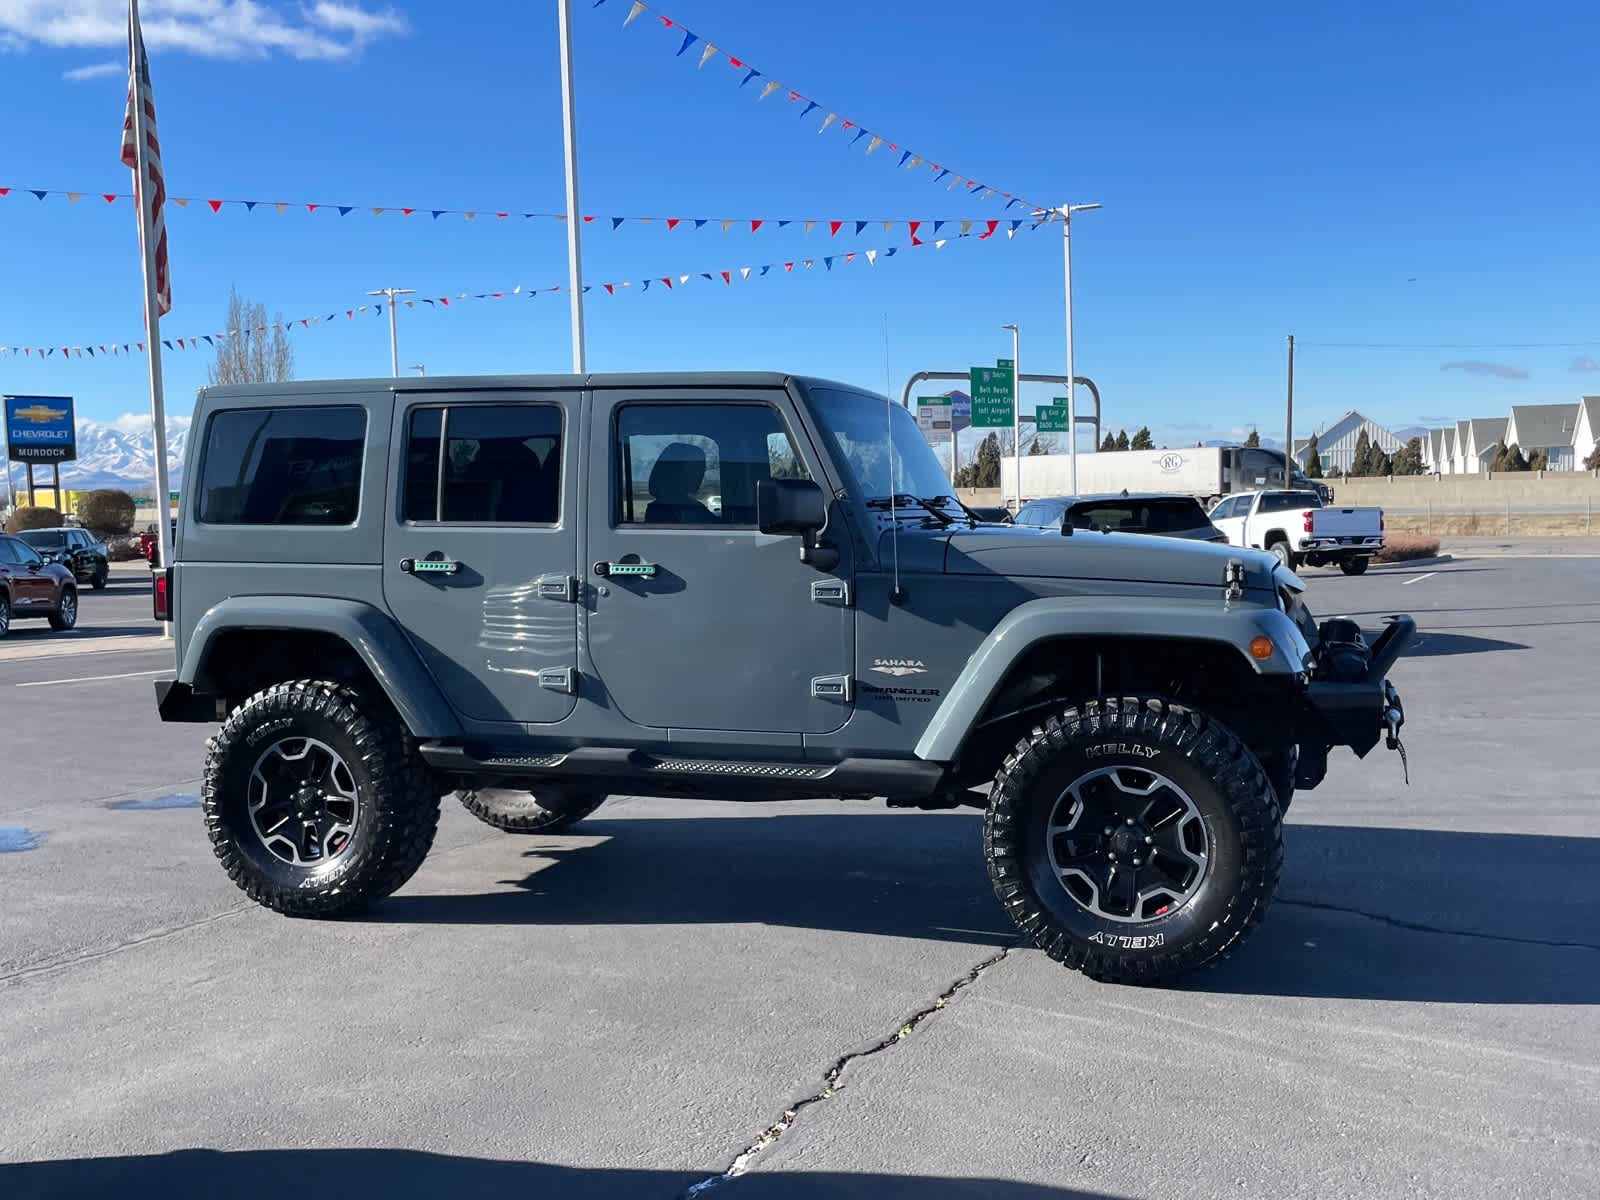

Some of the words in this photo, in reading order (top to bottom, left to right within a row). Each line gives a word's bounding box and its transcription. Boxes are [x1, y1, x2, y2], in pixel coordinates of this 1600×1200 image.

[12, 430, 69, 439] CHEVROLET
[18, 448, 65, 457] MURDOCK
[874, 658, 924, 667] SAHARA
[862, 686, 940, 696] WRANGLER
[1085, 743, 1161, 758] KELLY
[1088, 931, 1165, 949] KELLY
